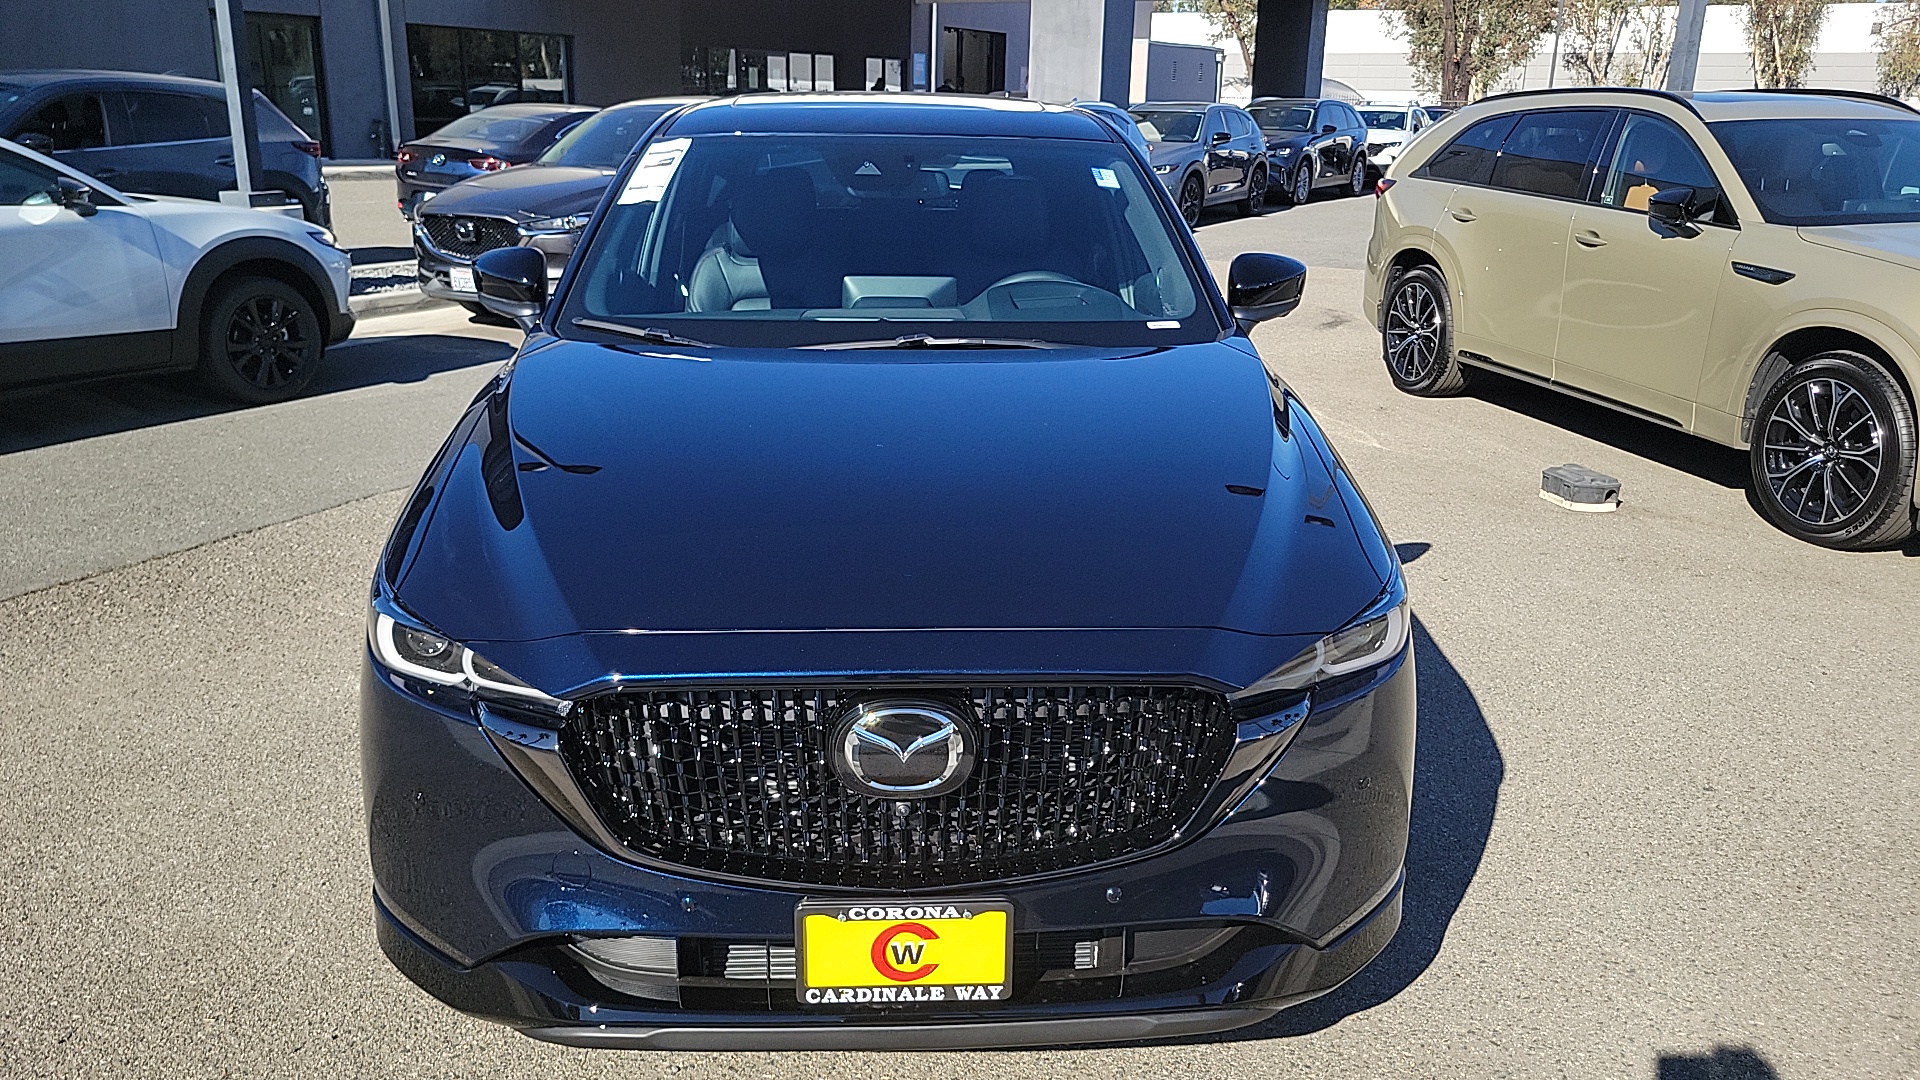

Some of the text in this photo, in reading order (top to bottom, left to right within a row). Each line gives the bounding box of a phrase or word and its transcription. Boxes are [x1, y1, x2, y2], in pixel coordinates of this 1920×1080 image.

[848, 906, 961, 920] CORONA
[871, 922, 940, 982] C
[891, 944, 925, 965] W
[805, 985, 1003, 1004] CARDINALE WAY
